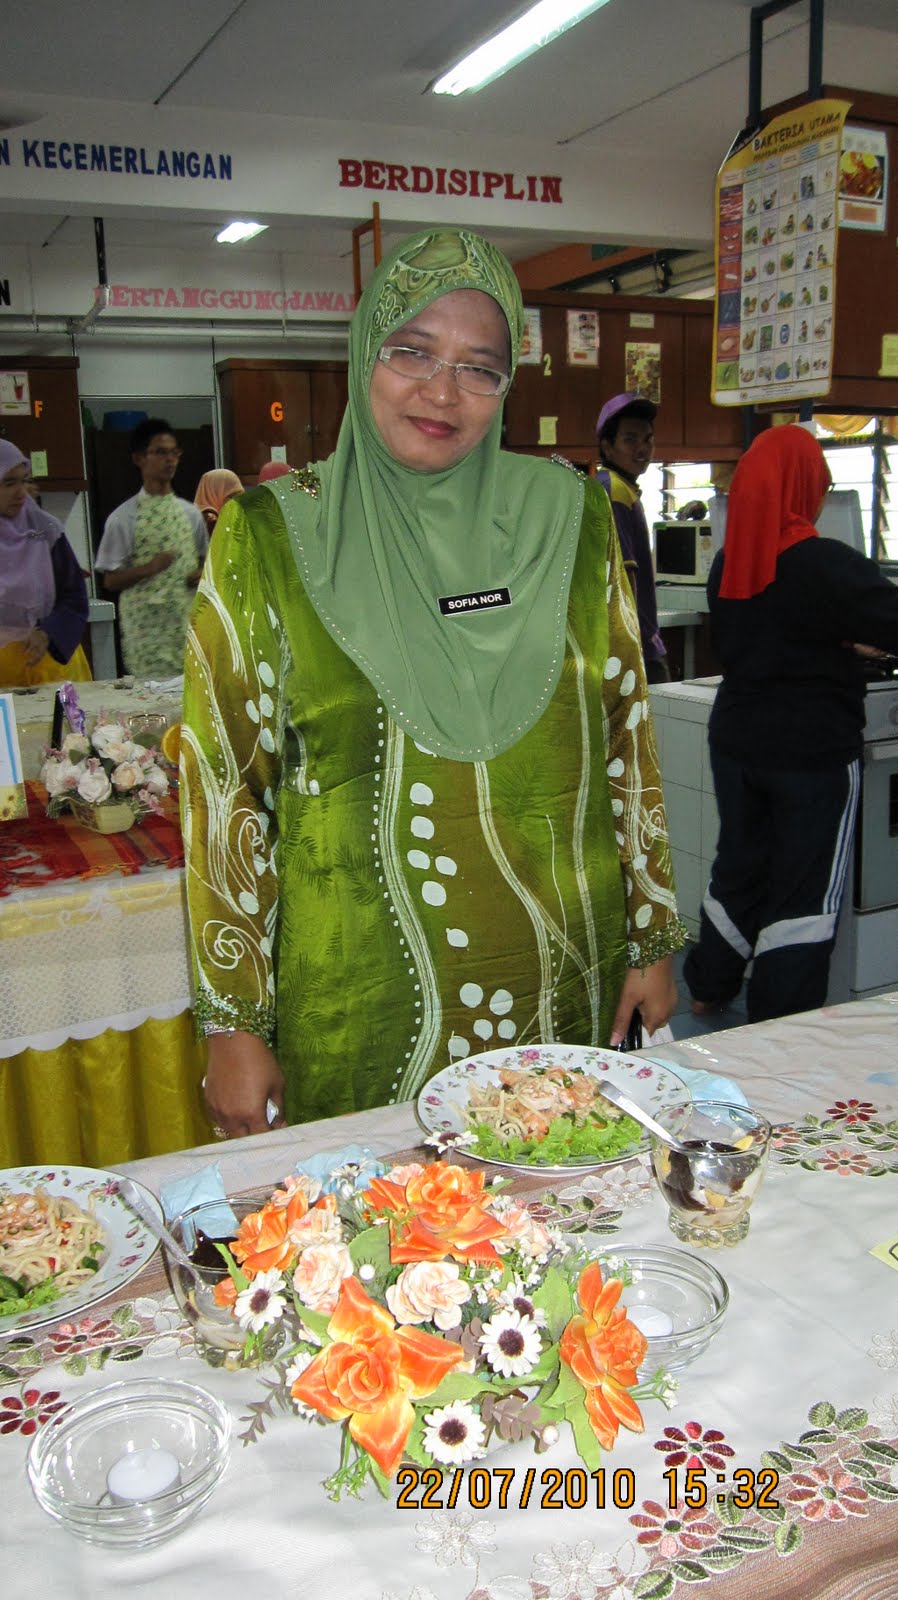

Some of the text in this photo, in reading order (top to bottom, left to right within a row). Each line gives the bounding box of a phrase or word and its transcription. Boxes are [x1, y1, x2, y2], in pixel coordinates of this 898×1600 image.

[753, 122, 805, 151] BAKTERIA
[809, 112, 841, 130] UTAMA
[22, 139, 232, 180] KECEMERLANGAN
[338, 159, 563, 203] BERDISIPLIN
[543, 353, 552, 376] 2
[34, 400, 44, 418] F
[270, 401, 284, 422] G
[448, 593, 503, 609] SOFIA NOR
